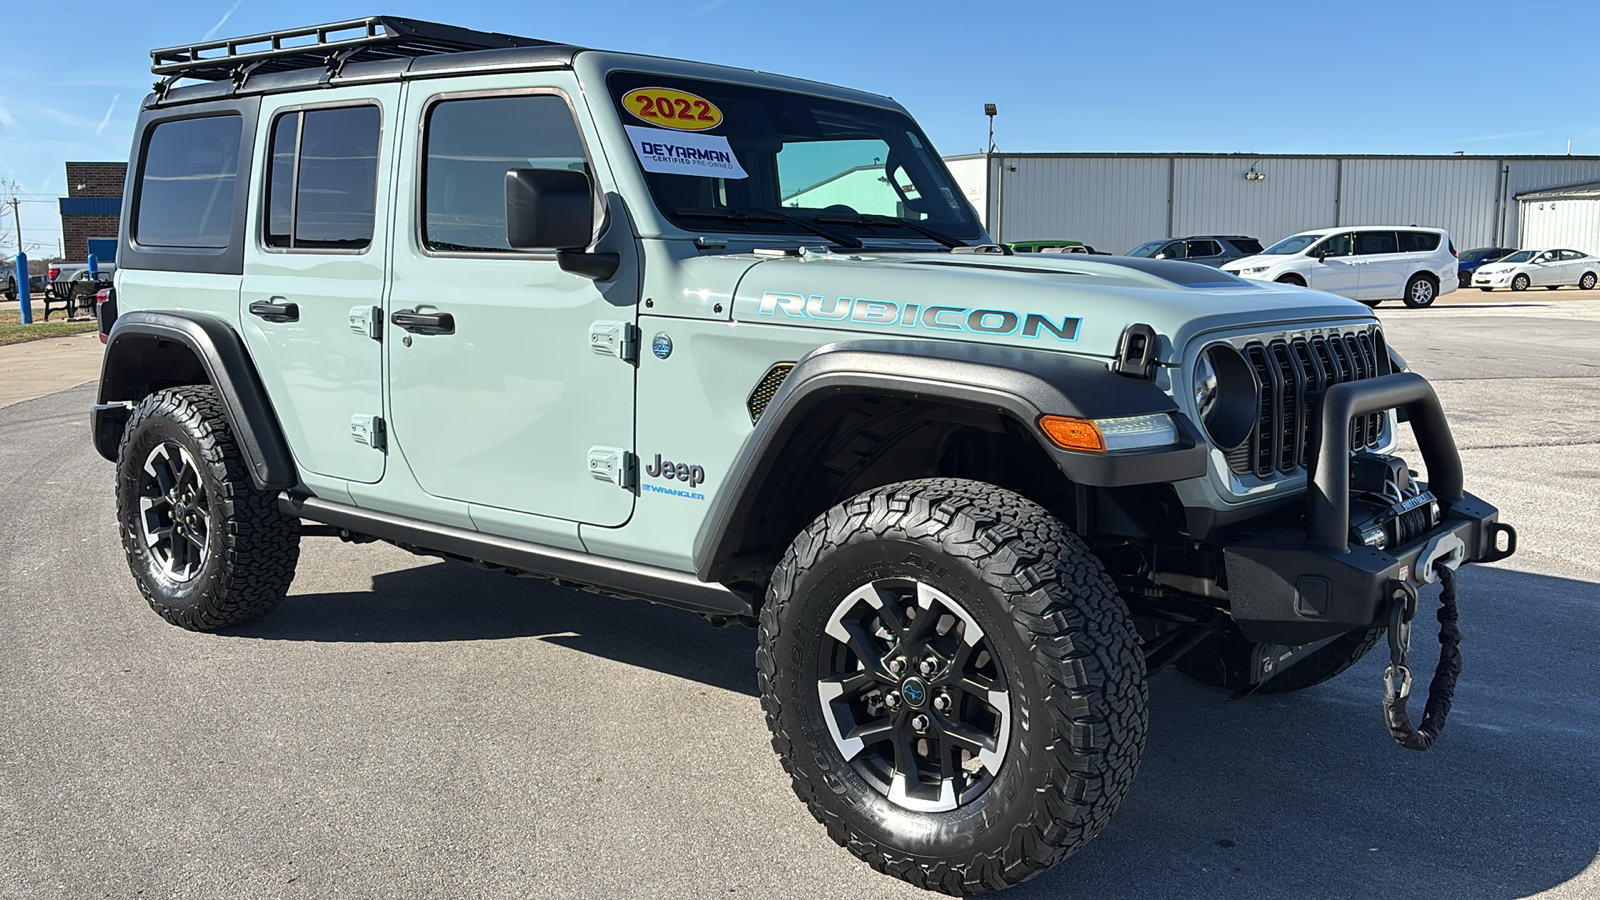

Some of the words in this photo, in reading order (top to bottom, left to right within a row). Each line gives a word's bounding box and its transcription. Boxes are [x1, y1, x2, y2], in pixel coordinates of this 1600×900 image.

[635, 95, 715, 122] 2022
[641, 141, 731, 163] DEYARMAN
[652, 155, 691, 165] CERTIFIED
[692, 159, 733, 169] PRE-OWNED
[759, 291, 1083, 342] RUBICON
[646, 454, 705, 488] Jeep
[651, 486, 705, 500] WRANGLER
